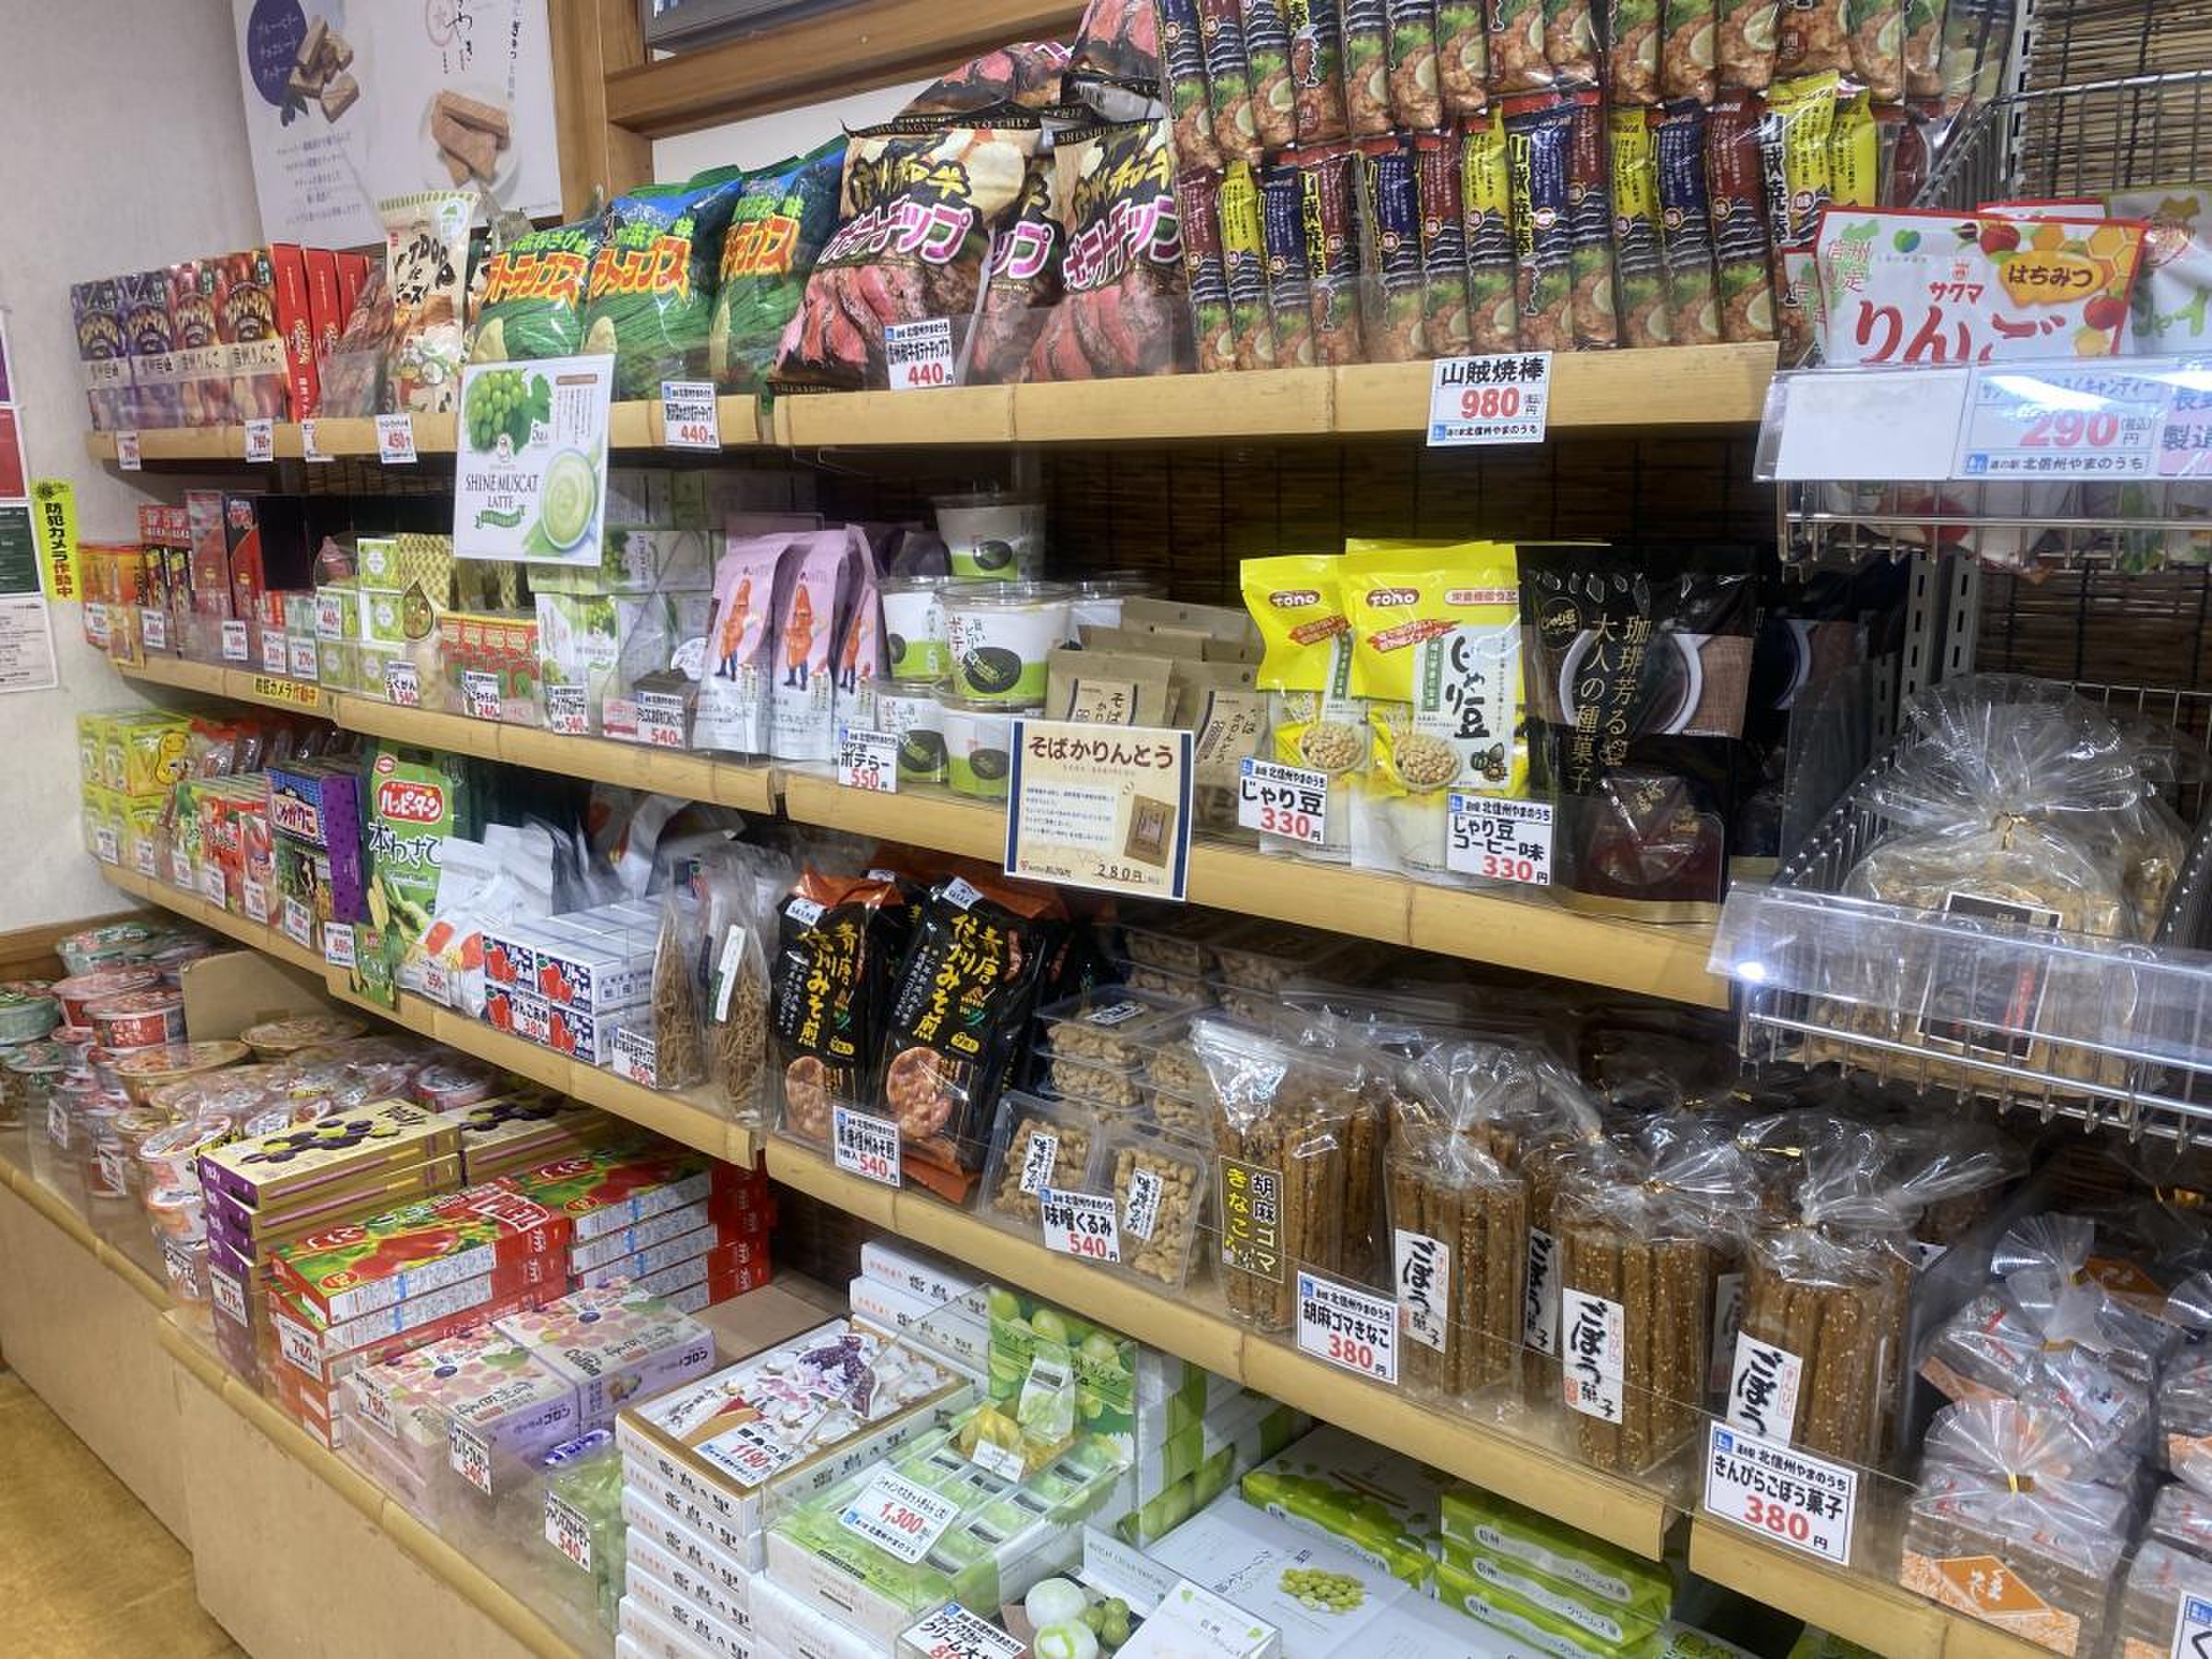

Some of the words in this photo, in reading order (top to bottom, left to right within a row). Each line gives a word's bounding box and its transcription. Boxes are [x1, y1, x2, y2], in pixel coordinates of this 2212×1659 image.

[2006, 264, 2094, 287] はちみつ
[1930, 281, 1984, 304] サクマ
[1855, 300, 2066, 367] りんご
[1441, 357, 1545, 385] 山賊焼棒
[1461, 387, 1520, 419] 980
[1465, 425, 1538, 436] 北信州やまのうち
[2020, 412, 2119, 447] 290
[2124, 433, 2139, 446] 円
[2022, 457, 2145, 472] 北信州やまのうち
[465, 474, 496, 492] SHINE
[497, 474, 538, 492] MUSCAT
[488, 496, 513, 509] LATTE
[1445, 635, 1490, 739] じゃり豆
[1030, 736, 1173, 769] そばかりんとう
[1241, 779, 1324, 817] じゃり豆
[1482, 802, 1550, 821] 北信州やまのうち
[1261, 806, 1321, 841] 330円
[1454, 816, 1515, 841] じゃり豆
[1453, 833, 1545, 861] コーヒー味
[1483, 855, 1548, 884] 330円
[1044, 1204, 1112, 1237] 味噌くるみ
[1253, 1173, 1277, 1273] 胡麻ゴマ
[1069, 1232, 1117, 1262] 540円
[1331, 1291, 1391, 1322] 北信州やまのうち
[1302, 1300, 1390, 1348] 胡麻ゴマきなこ
[1328, 1334, 1387, 1375] 380円
[1759, 1450, 1847, 1492] 北信州やまのうち
[1714, 1454, 1843, 1520] きんぴらごぼう菓子
[1744, 1494, 1829, 1550] 380円
